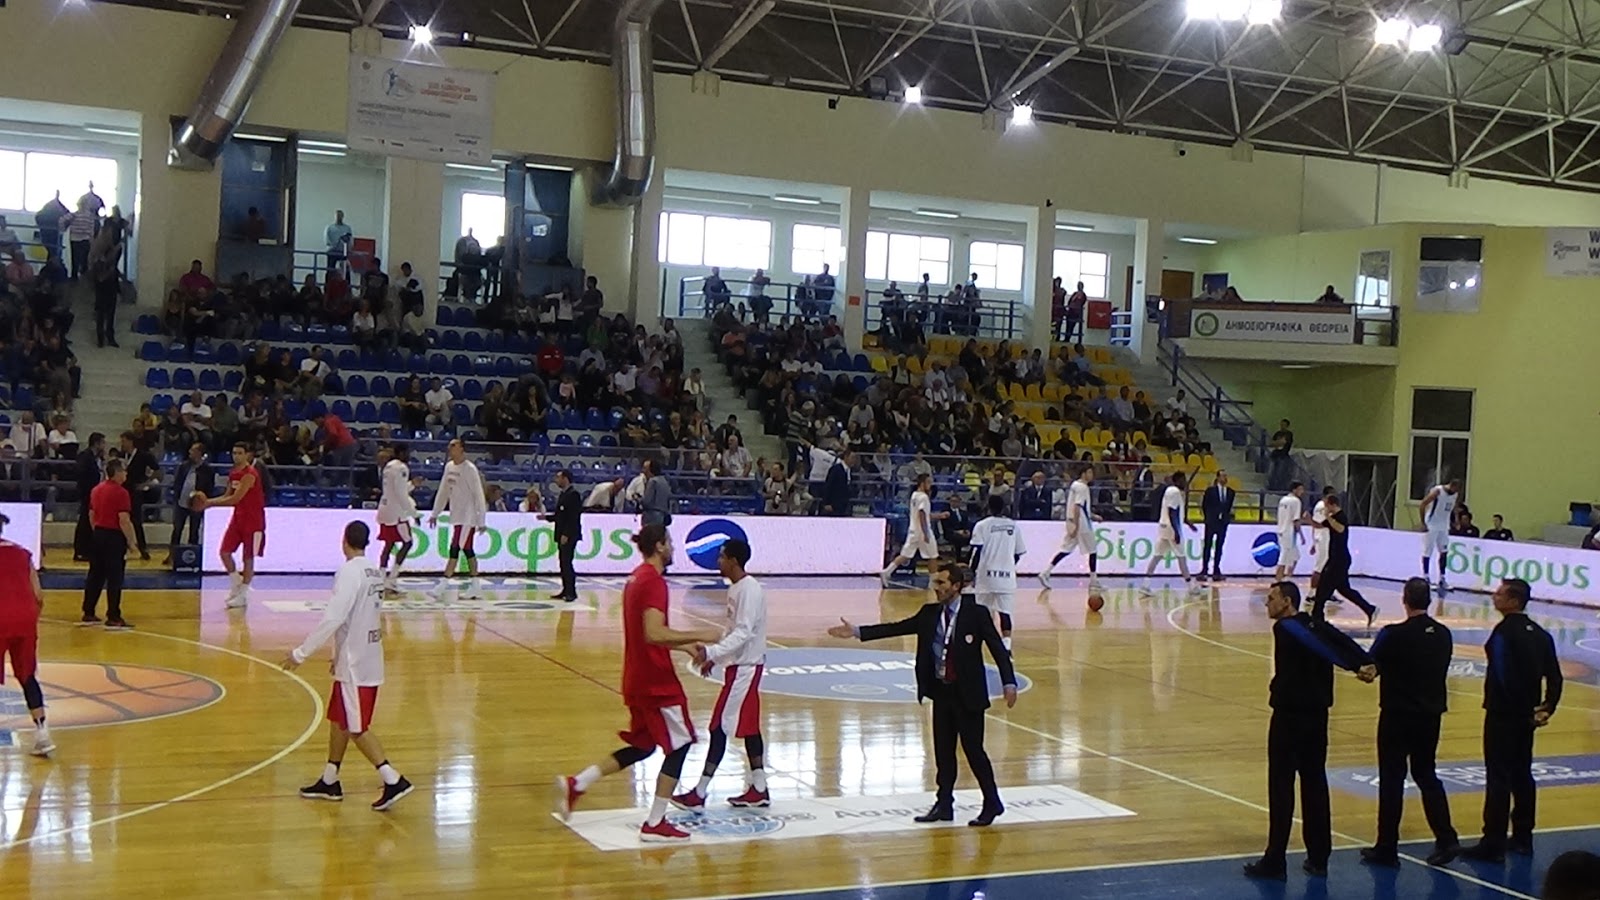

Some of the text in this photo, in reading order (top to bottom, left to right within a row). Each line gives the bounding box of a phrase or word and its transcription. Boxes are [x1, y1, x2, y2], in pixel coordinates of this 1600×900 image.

[1225, 320, 1349, 334] ΔΗΜΟΣΙΟΓΡΑΦΙΚΑ ΘΕΩΡΕΙΑ
[762, 660, 917, 676] OIXIMA
